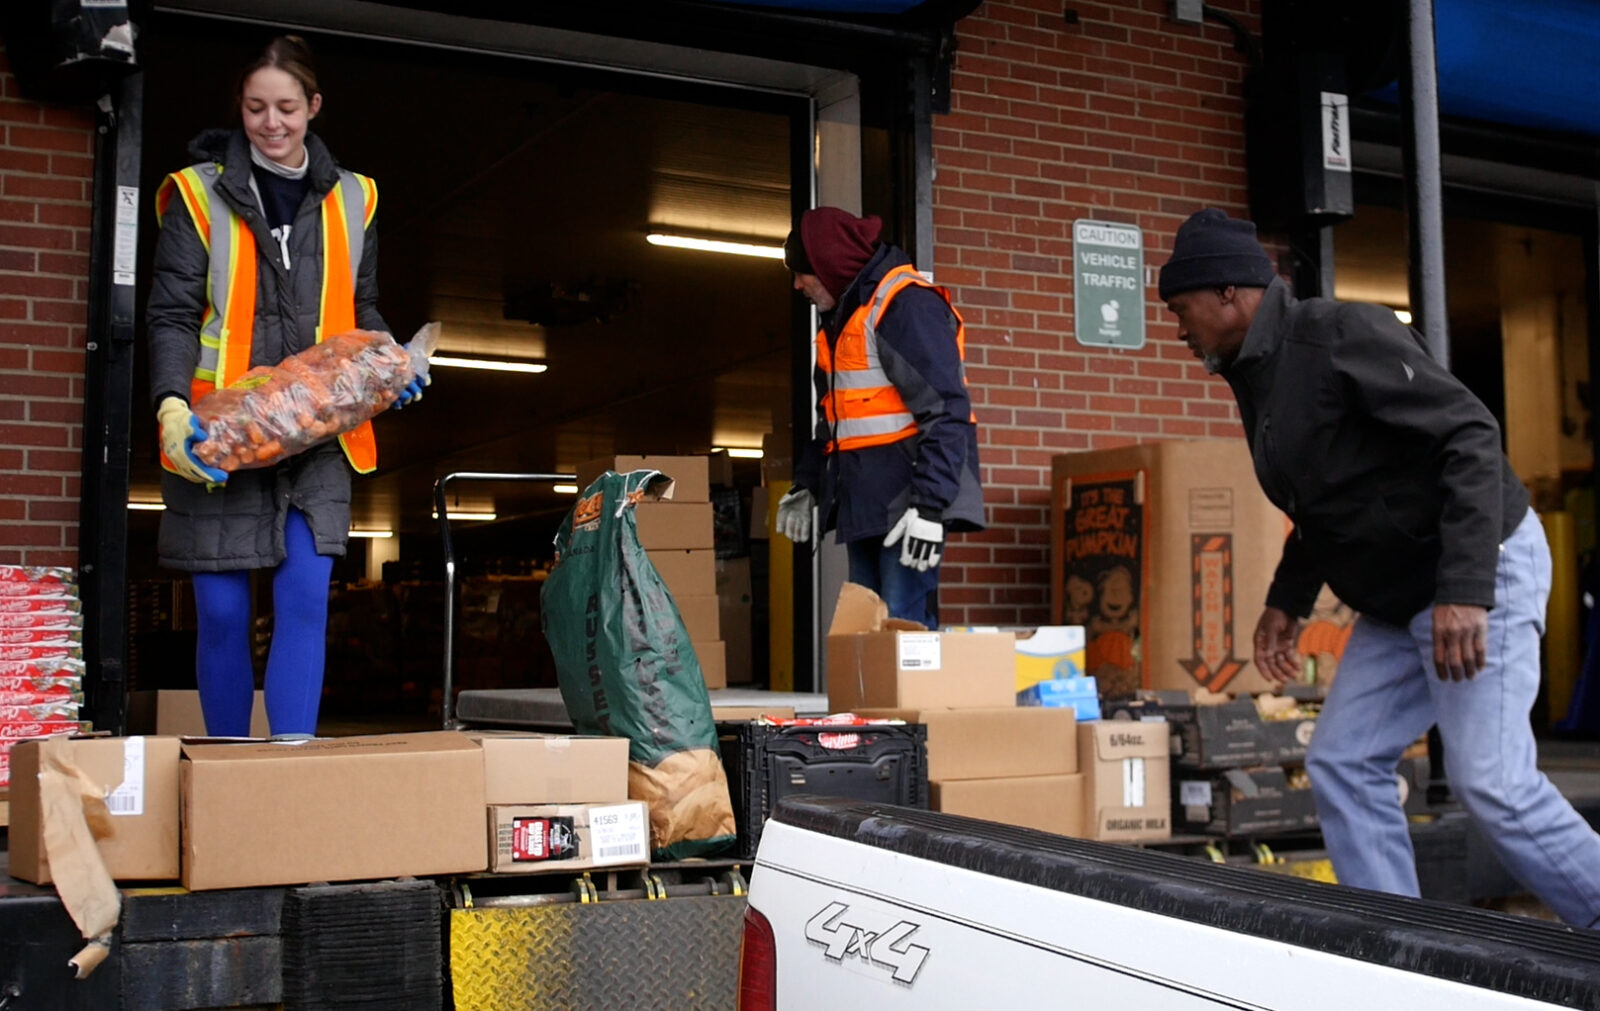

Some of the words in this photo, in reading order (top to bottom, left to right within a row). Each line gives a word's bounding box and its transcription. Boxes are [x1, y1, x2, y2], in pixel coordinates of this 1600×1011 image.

[1079, 227, 1137, 245] CAUTION
[1080, 251, 1137, 270] VEHICLE
[1081, 272, 1137, 290] TRAFFIC
[1103, 487, 1124, 504] THE
[1075, 505, 1131, 533] GREAT
[1065, 532, 1138, 562] PUMPKIN
[1204, 557, 1220, 613] WATCH
[1205, 621, 1220, 664] STEP
[1106, 820, 1142, 831] ORGANIC
[1145, 820, 1165, 830] MILK
[805, 901, 930, 985] 4x4
